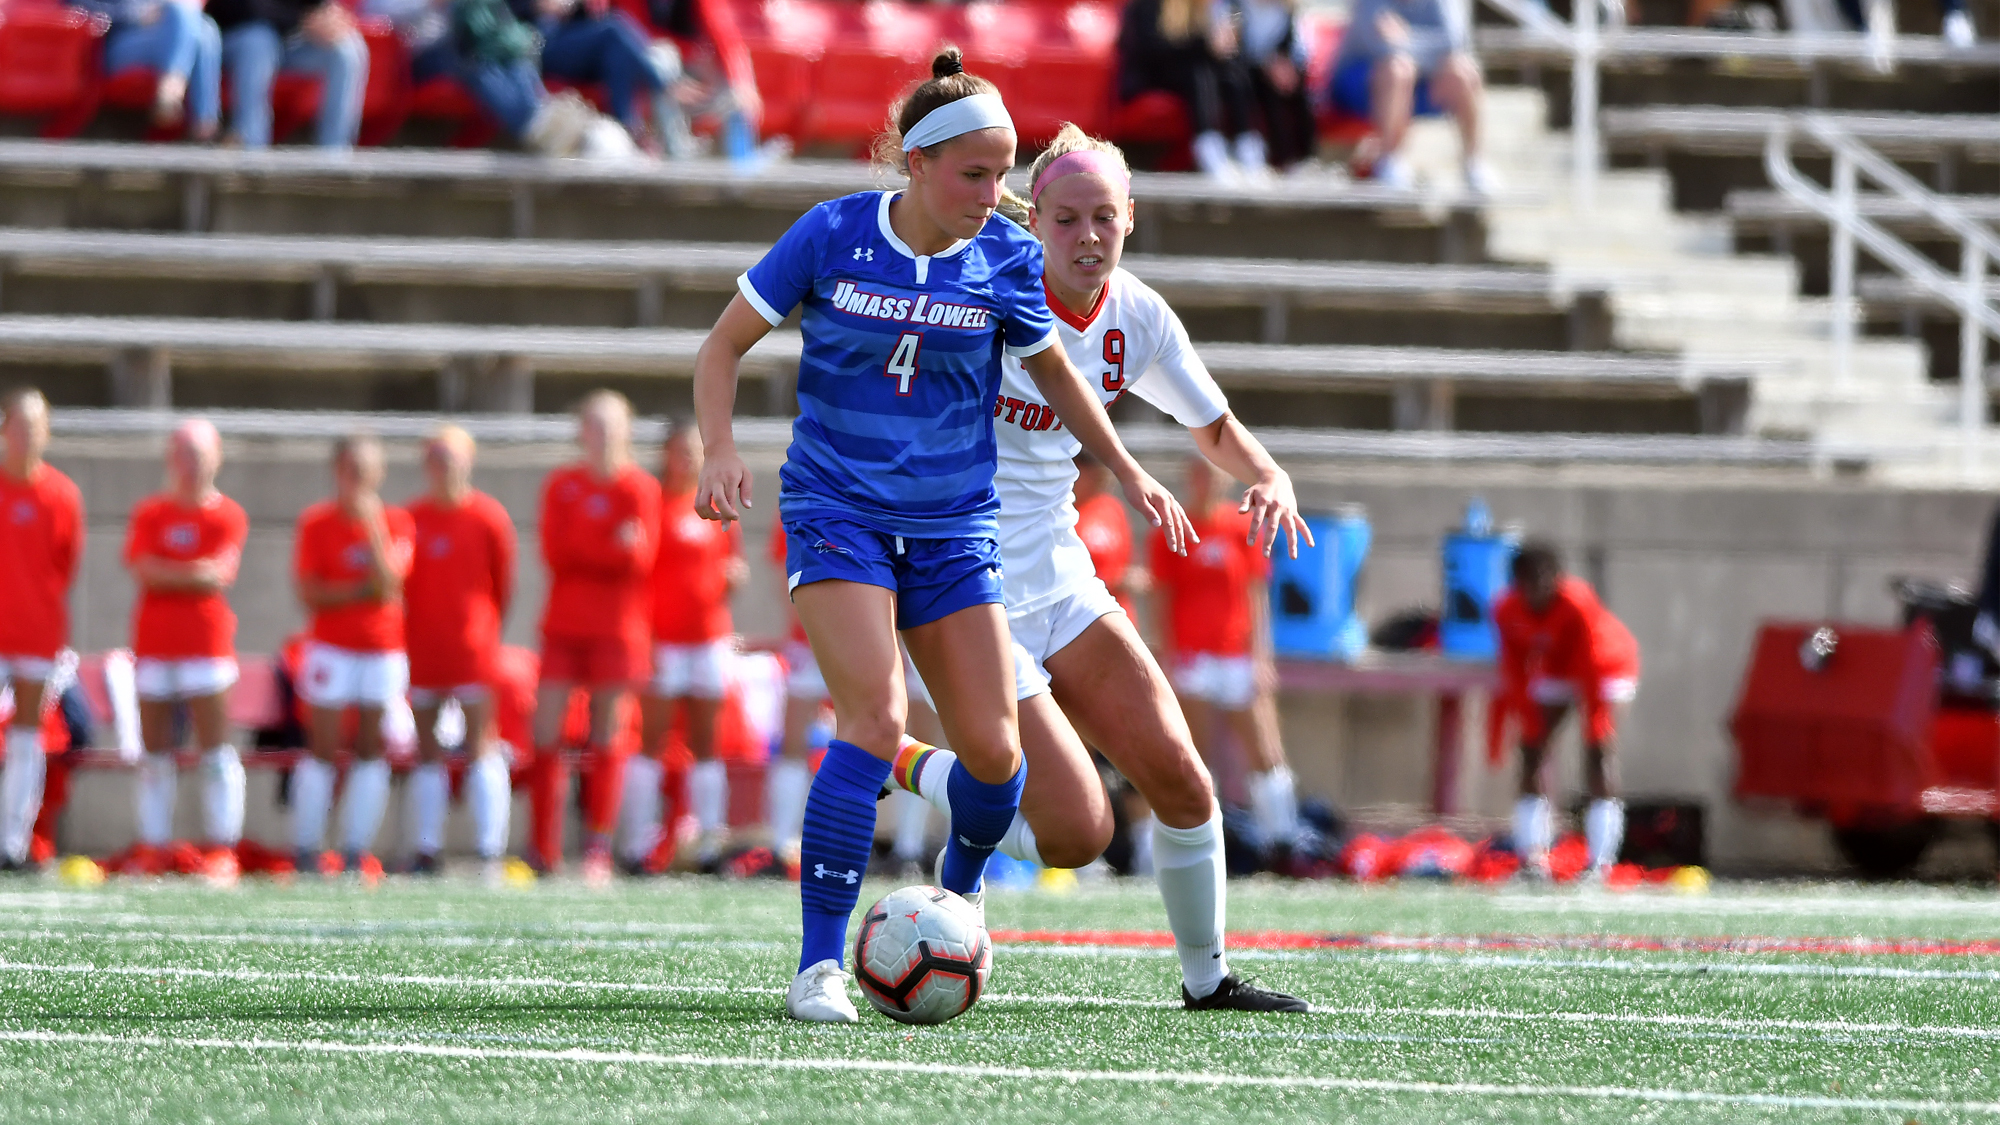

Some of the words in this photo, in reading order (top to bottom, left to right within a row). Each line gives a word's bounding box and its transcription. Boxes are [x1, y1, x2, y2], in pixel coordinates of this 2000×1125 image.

[832, 281, 911, 322] UMASS
[909, 294, 990, 328] LOWELL
[885, 331, 922, 395] 4
[1102, 329, 1125, 391] 9
[994, 395, 1063, 431] STON
